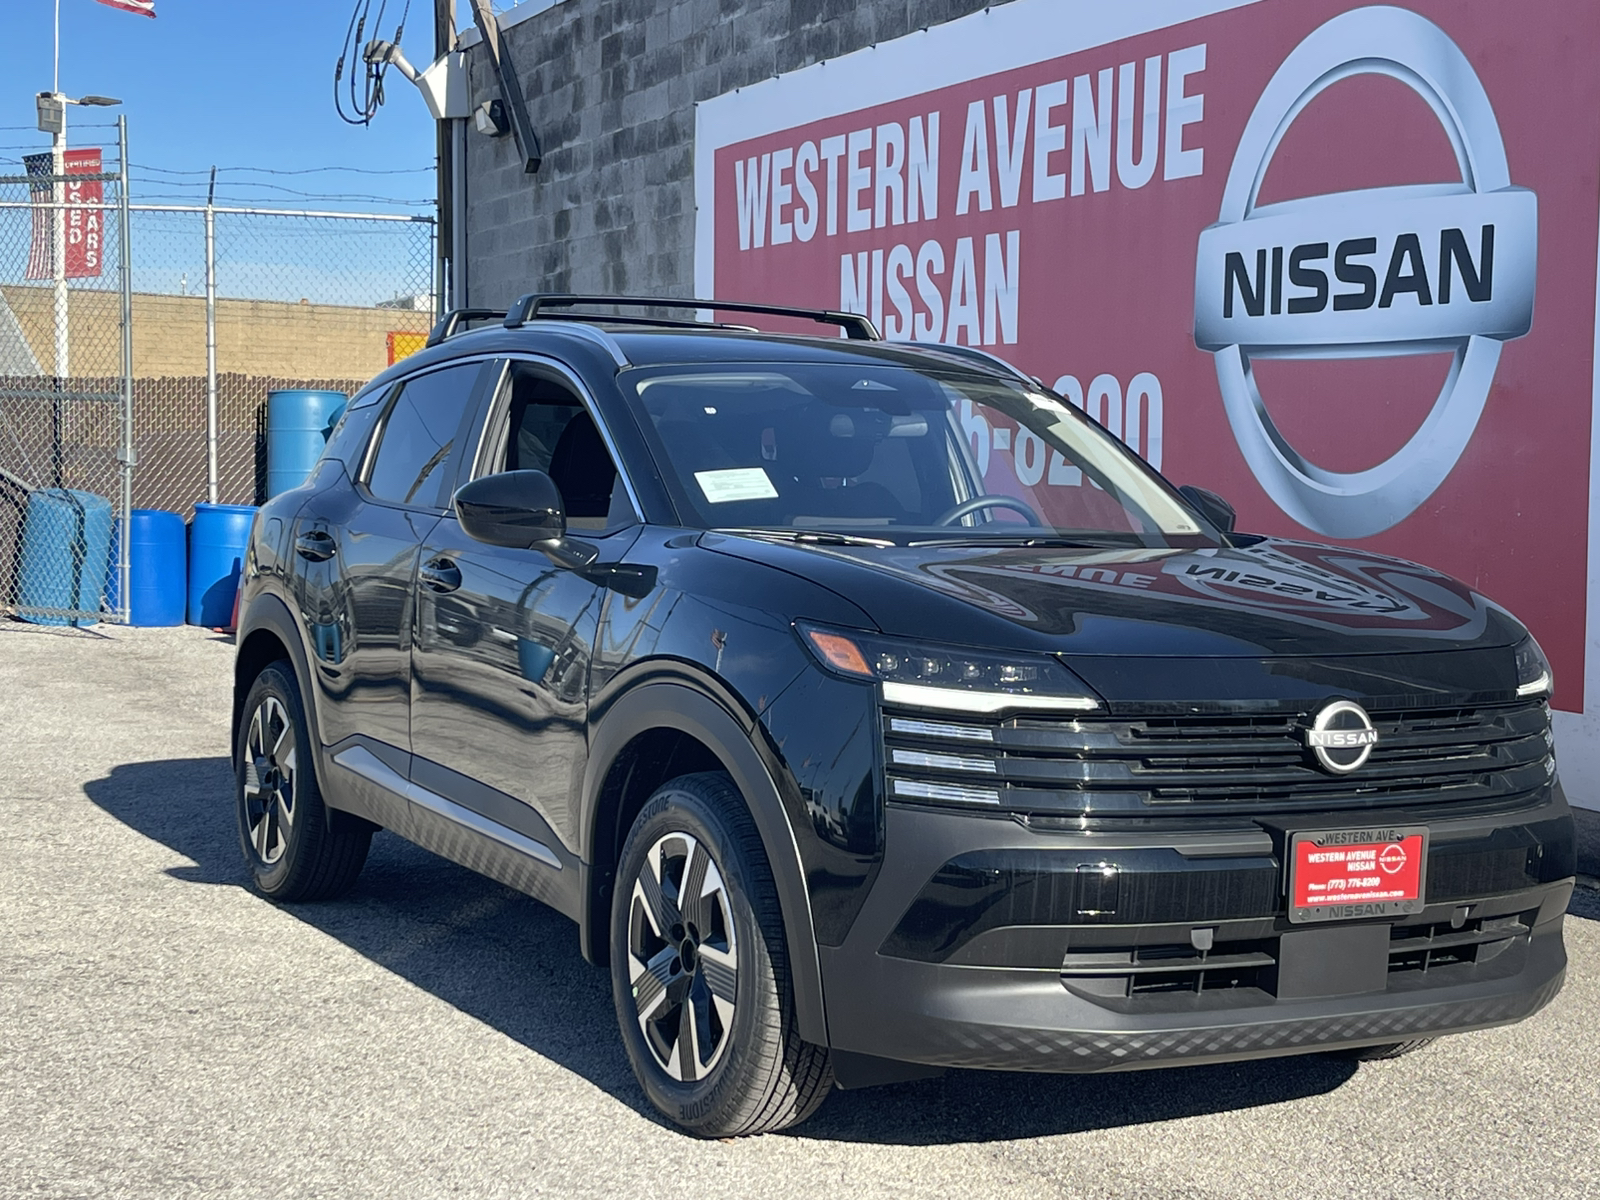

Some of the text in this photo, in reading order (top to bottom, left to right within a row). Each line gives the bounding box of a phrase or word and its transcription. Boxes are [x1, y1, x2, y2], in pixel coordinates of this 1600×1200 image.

[735, 42, 1207, 251] WESTERN AVENUE
[69, 180, 82, 244] USED
[86, 196, 99, 268] CARS
[1223, 223, 1495, 319] NISSAN
[840, 229, 1020, 346] NISSAN
[1312, 731, 1377, 745] NISSAN
[1325, 832, 1372, 844] WESTERN
[1308, 850, 1376, 863] WESTERN AVENUE
[1347, 861, 1376, 872] NISSAN
[1327, 879, 1347, 891] (773)
[1329, 903, 1385, 918] NISSAN
